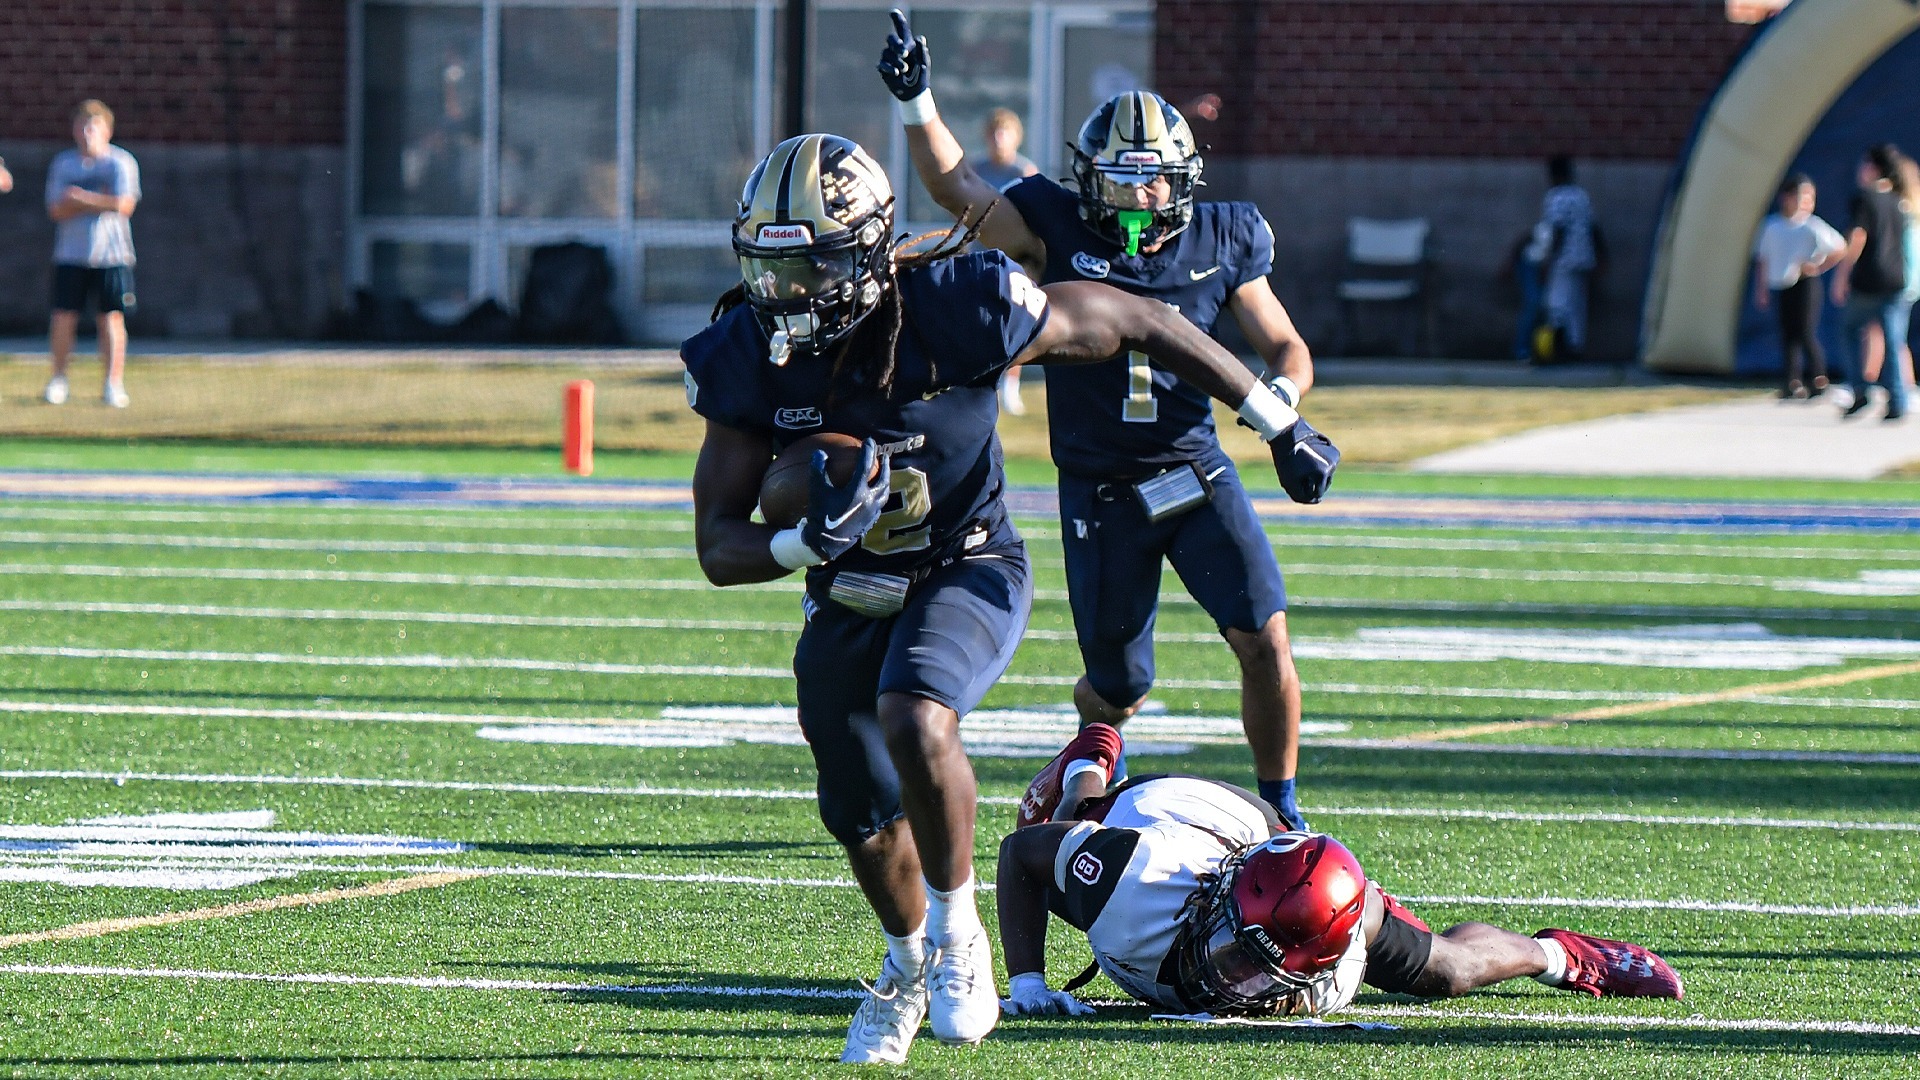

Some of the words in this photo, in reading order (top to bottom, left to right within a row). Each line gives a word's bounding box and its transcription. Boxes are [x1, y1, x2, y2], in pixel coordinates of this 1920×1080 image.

[763, 229, 802, 238] Riddell
[782, 409, 819, 423] SAC
[861, 466, 931, 556] 2
[1073, 851, 1103, 885] 8
[1255, 930, 1283, 958] BEARS
